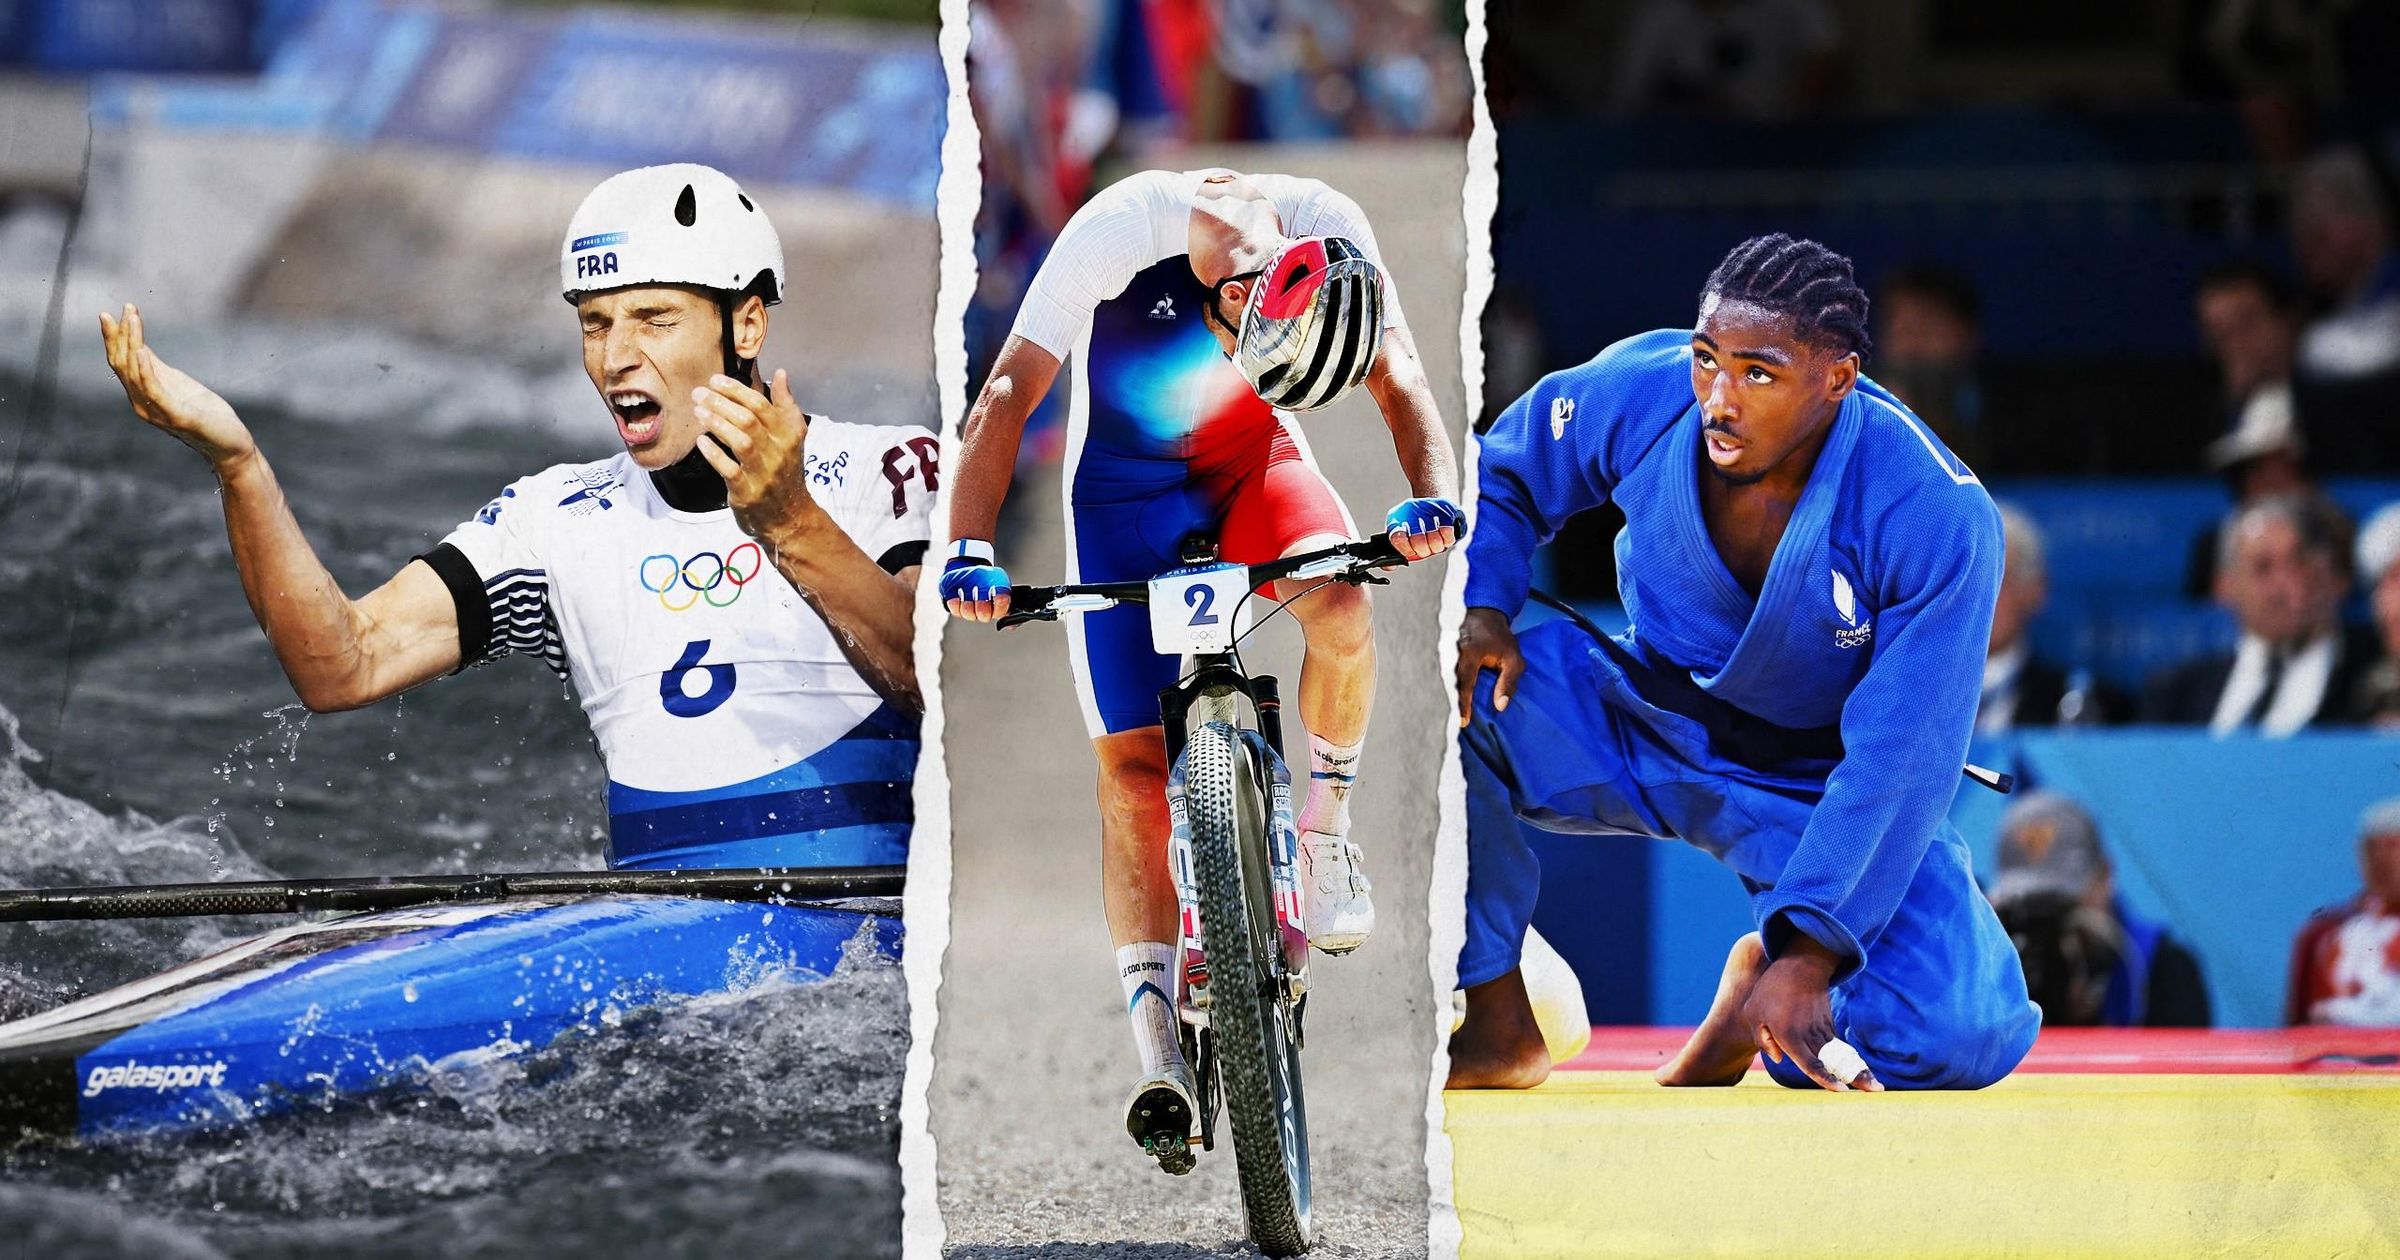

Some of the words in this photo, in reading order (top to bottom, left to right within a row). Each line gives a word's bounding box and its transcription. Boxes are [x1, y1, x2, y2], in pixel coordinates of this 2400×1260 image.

[577, 252, 619, 279] FRA
[1250, 246, 1287, 361] SPECIALIZED
[1185, 556, 1214, 564] wahoo
[1184, 583, 1219, 627] 2
[1835, 621, 1872, 639] FRANCE
[659, 638, 737, 718] 6
[83, 1059, 228, 1097] galasport
